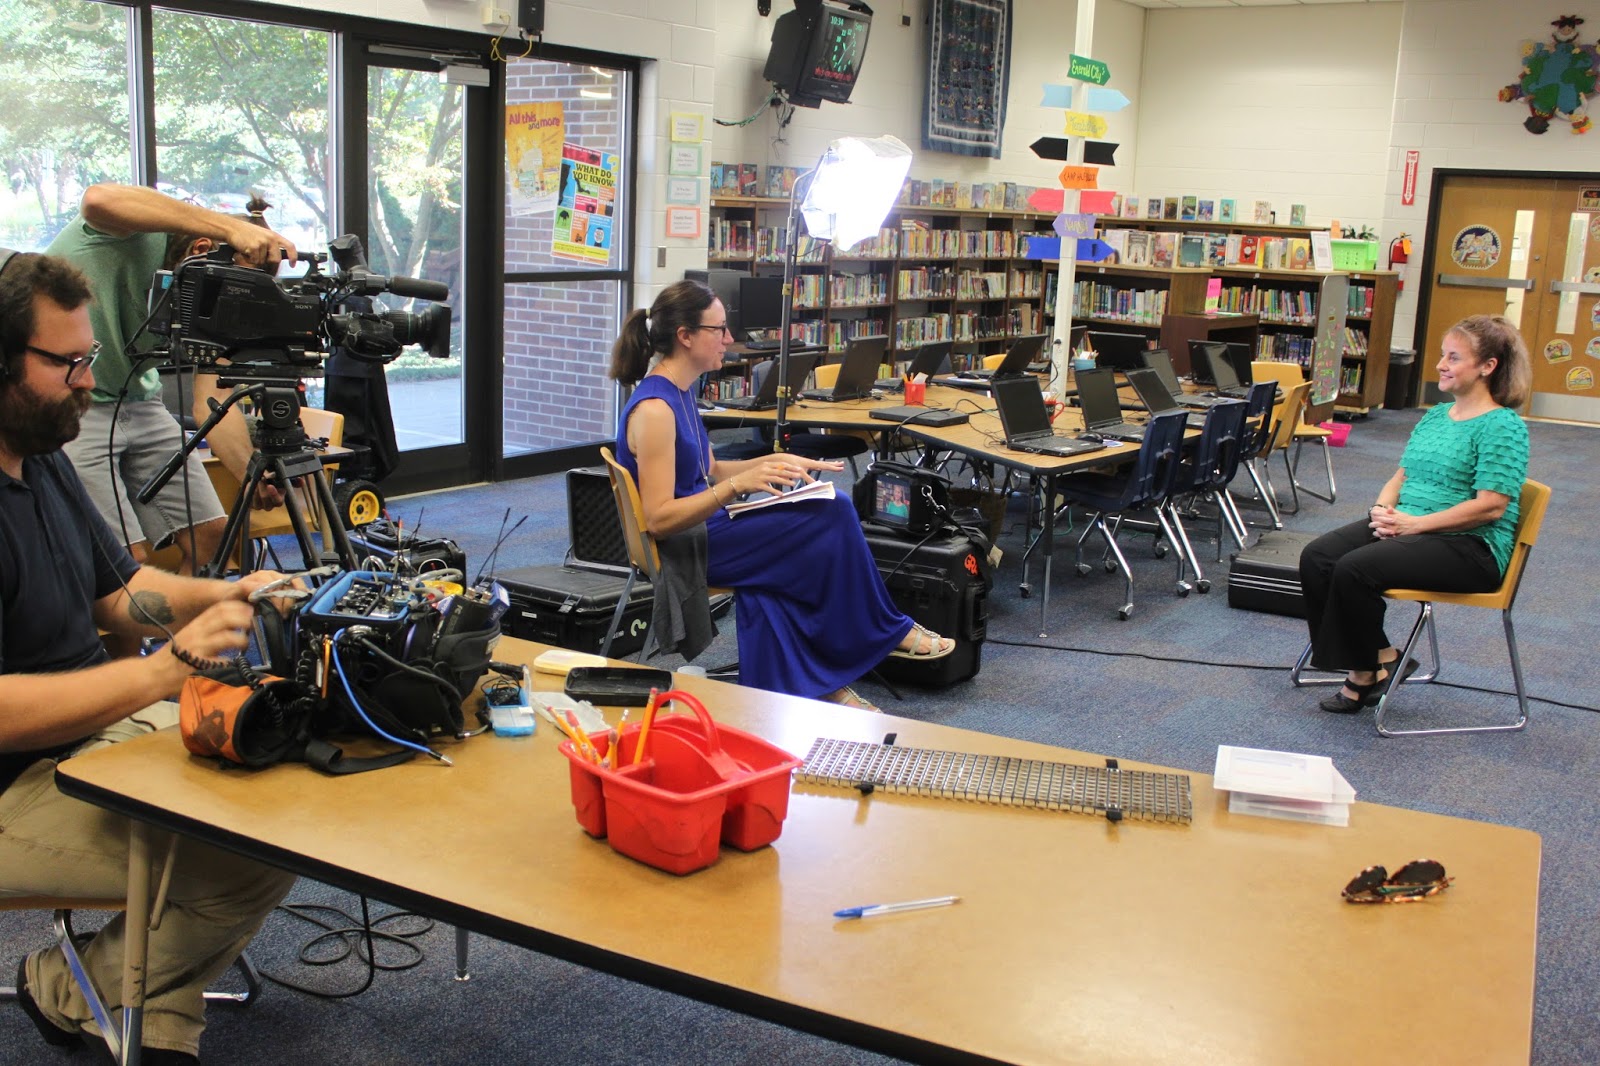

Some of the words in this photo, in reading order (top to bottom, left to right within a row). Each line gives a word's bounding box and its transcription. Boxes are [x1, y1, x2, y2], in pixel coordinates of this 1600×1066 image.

[1071, 59, 1091, 77] Emerald
[1091, 64, 1102, 83] City
[509, 112, 520, 125] All
[522, 111, 536, 124] this
[528, 120, 540, 130] and
[540, 117, 560, 127] more
[573, 170, 590, 182] YOU
[589, 174, 615, 187] KNOW
[575, 163, 600, 176] WHAT
[600, 169, 612, 179] DO
